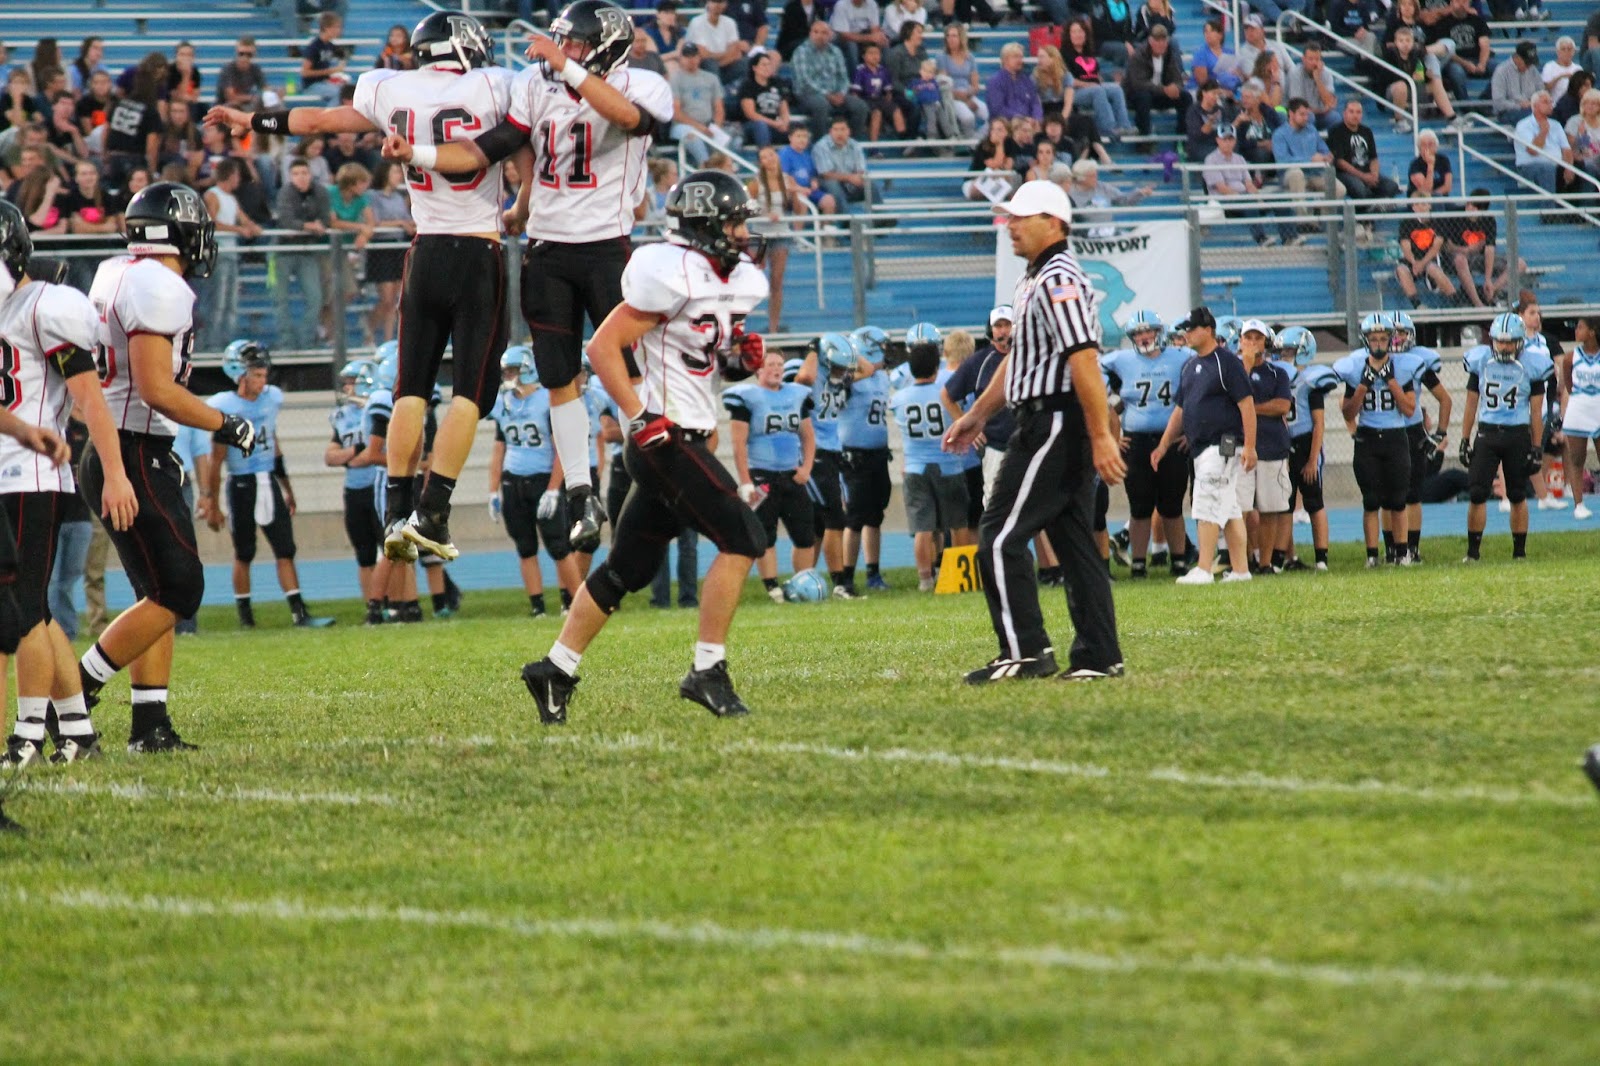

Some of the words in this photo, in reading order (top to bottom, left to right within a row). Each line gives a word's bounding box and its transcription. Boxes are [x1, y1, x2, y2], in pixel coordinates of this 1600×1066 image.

[538, 119, 598, 191] 11
[683, 181, 718, 217] R
[1070, 235, 1151, 255] SUPPORT
[1134, 380, 1172, 408] 74
[1484, 381, 1518, 410] 54
[905, 402, 945, 438] 29
